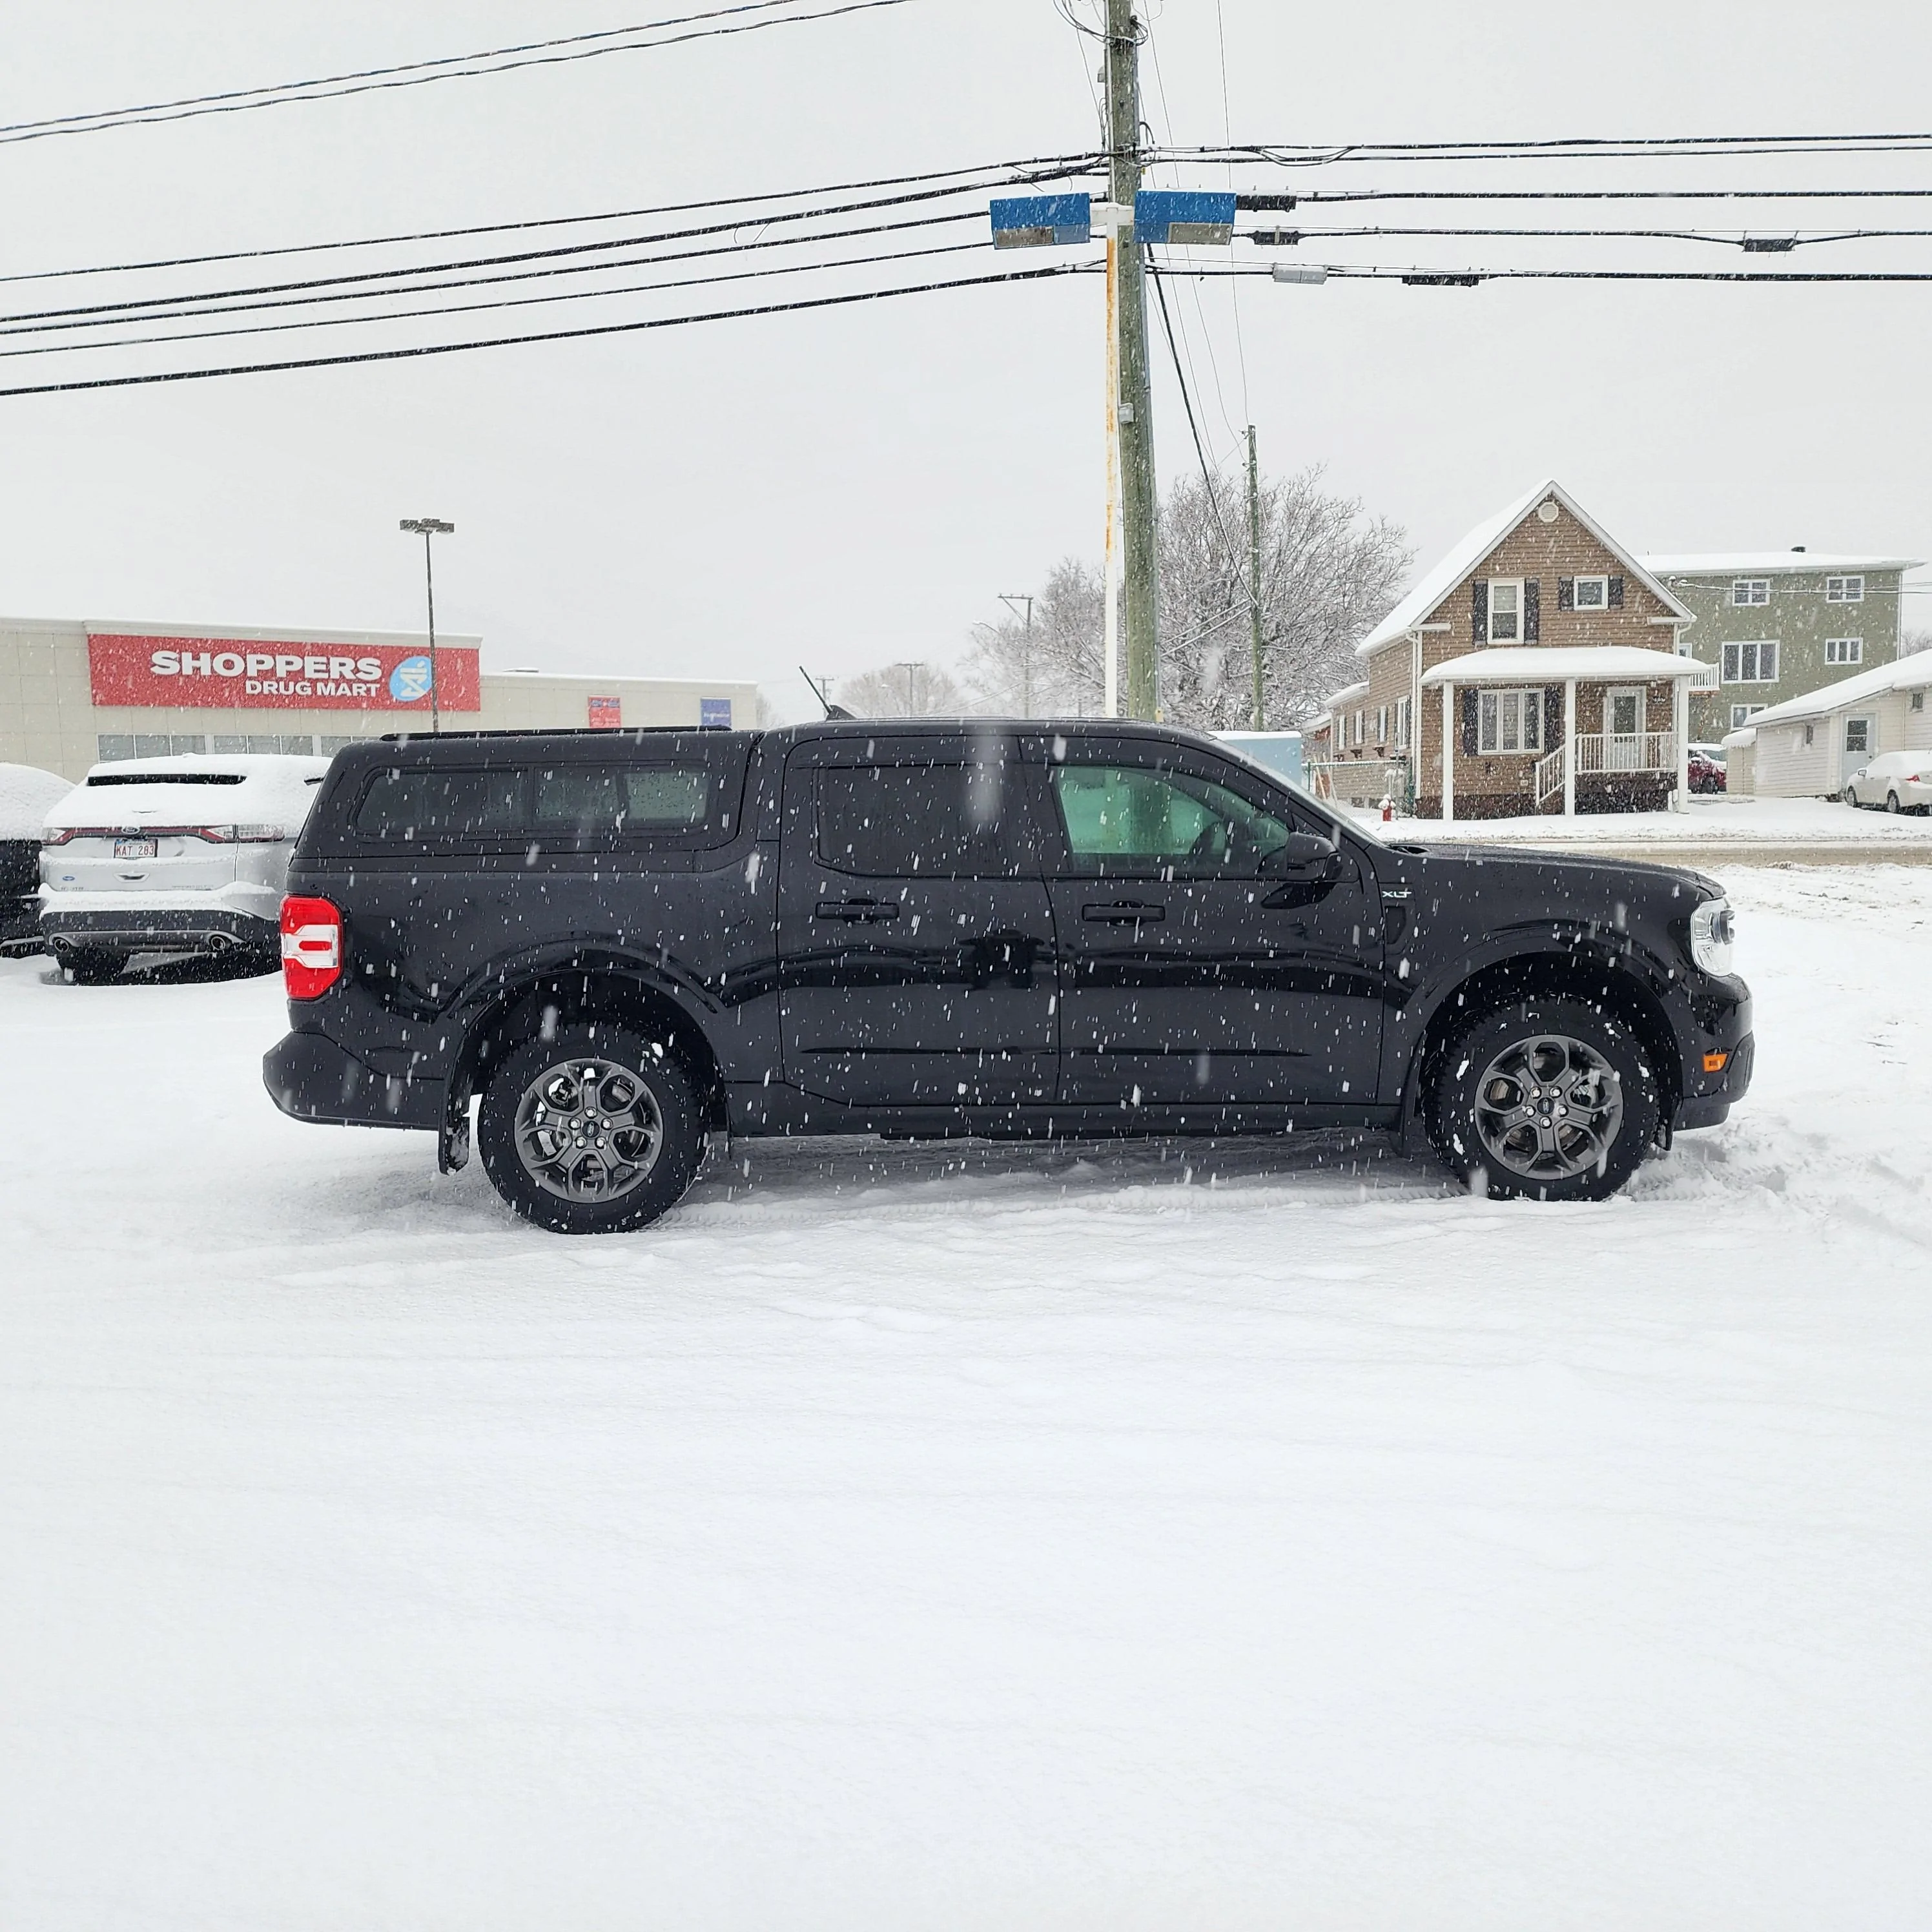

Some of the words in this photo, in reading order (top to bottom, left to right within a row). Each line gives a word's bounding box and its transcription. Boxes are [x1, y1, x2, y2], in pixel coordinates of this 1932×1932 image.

[150, 650, 382, 681] SHOPPERS
[246, 681, 312, 695] DRUG
[316, 683, 380, 697] MART
[116, 845, 132, 856] KAT
